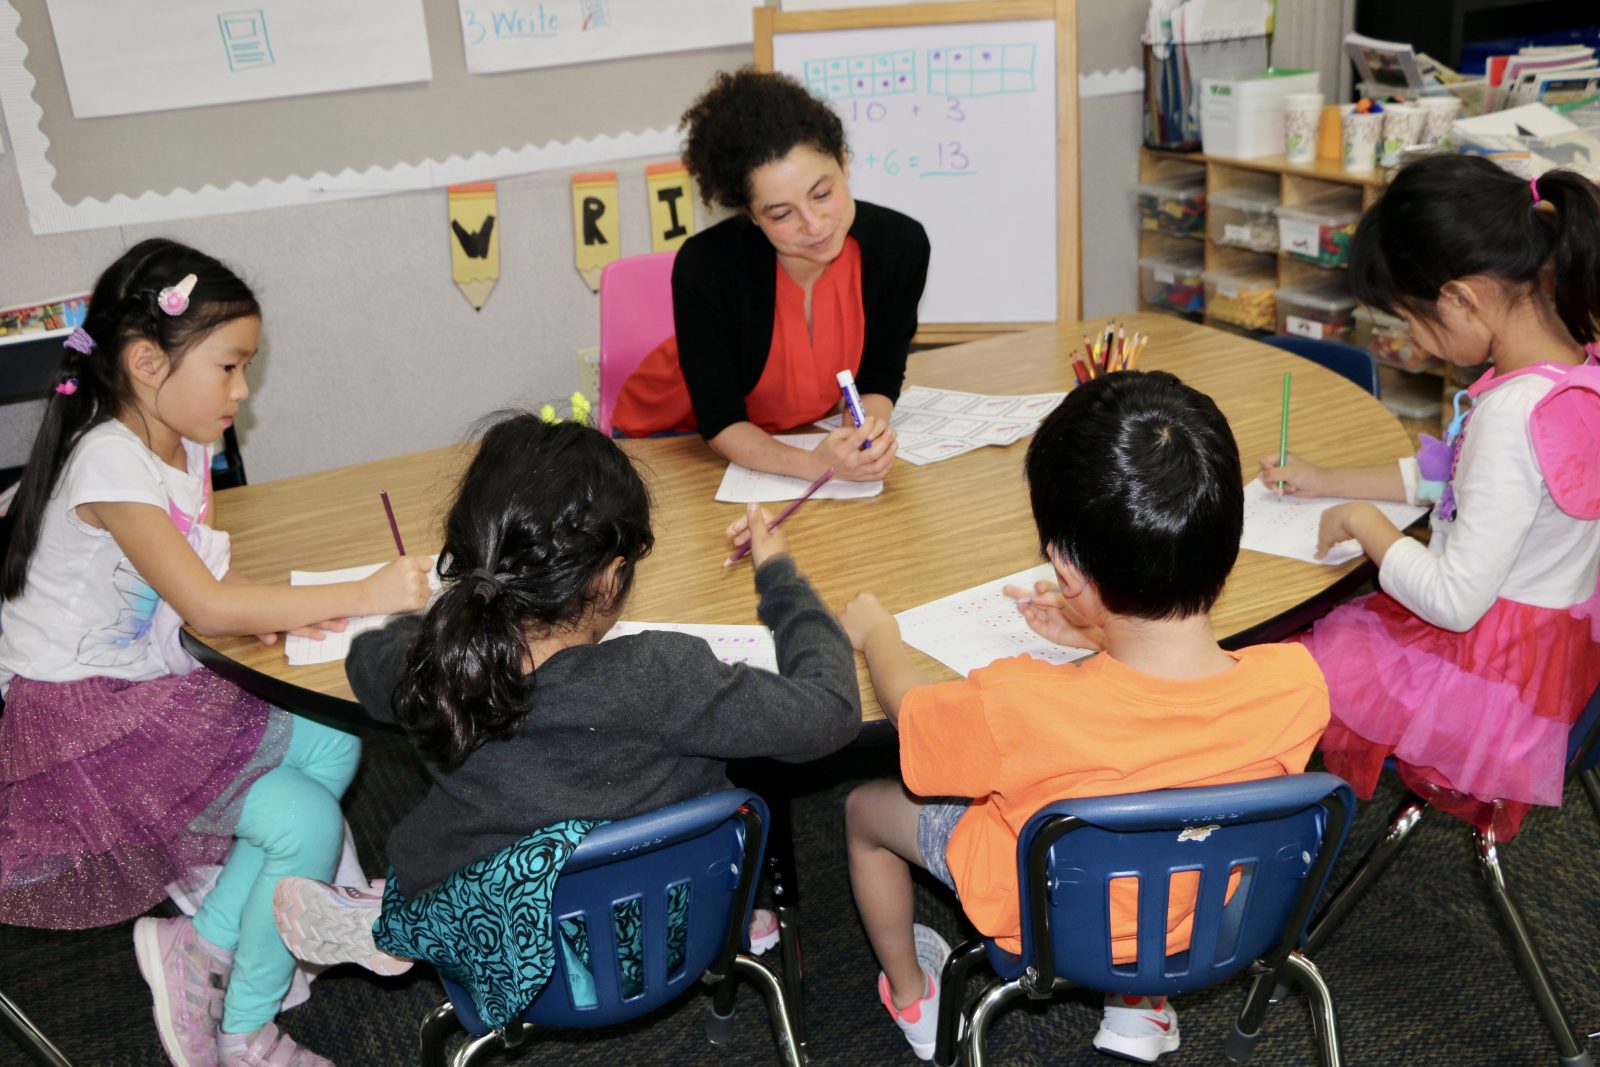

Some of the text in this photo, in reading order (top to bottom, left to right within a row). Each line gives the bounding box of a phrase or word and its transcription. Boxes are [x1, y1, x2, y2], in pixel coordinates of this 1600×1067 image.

[466, 5, 559, 45] 3 Write
[852, 100, 888, 122] 10
[946, 97, 966, 122] 3
[938, 141, 970, 170] 13
